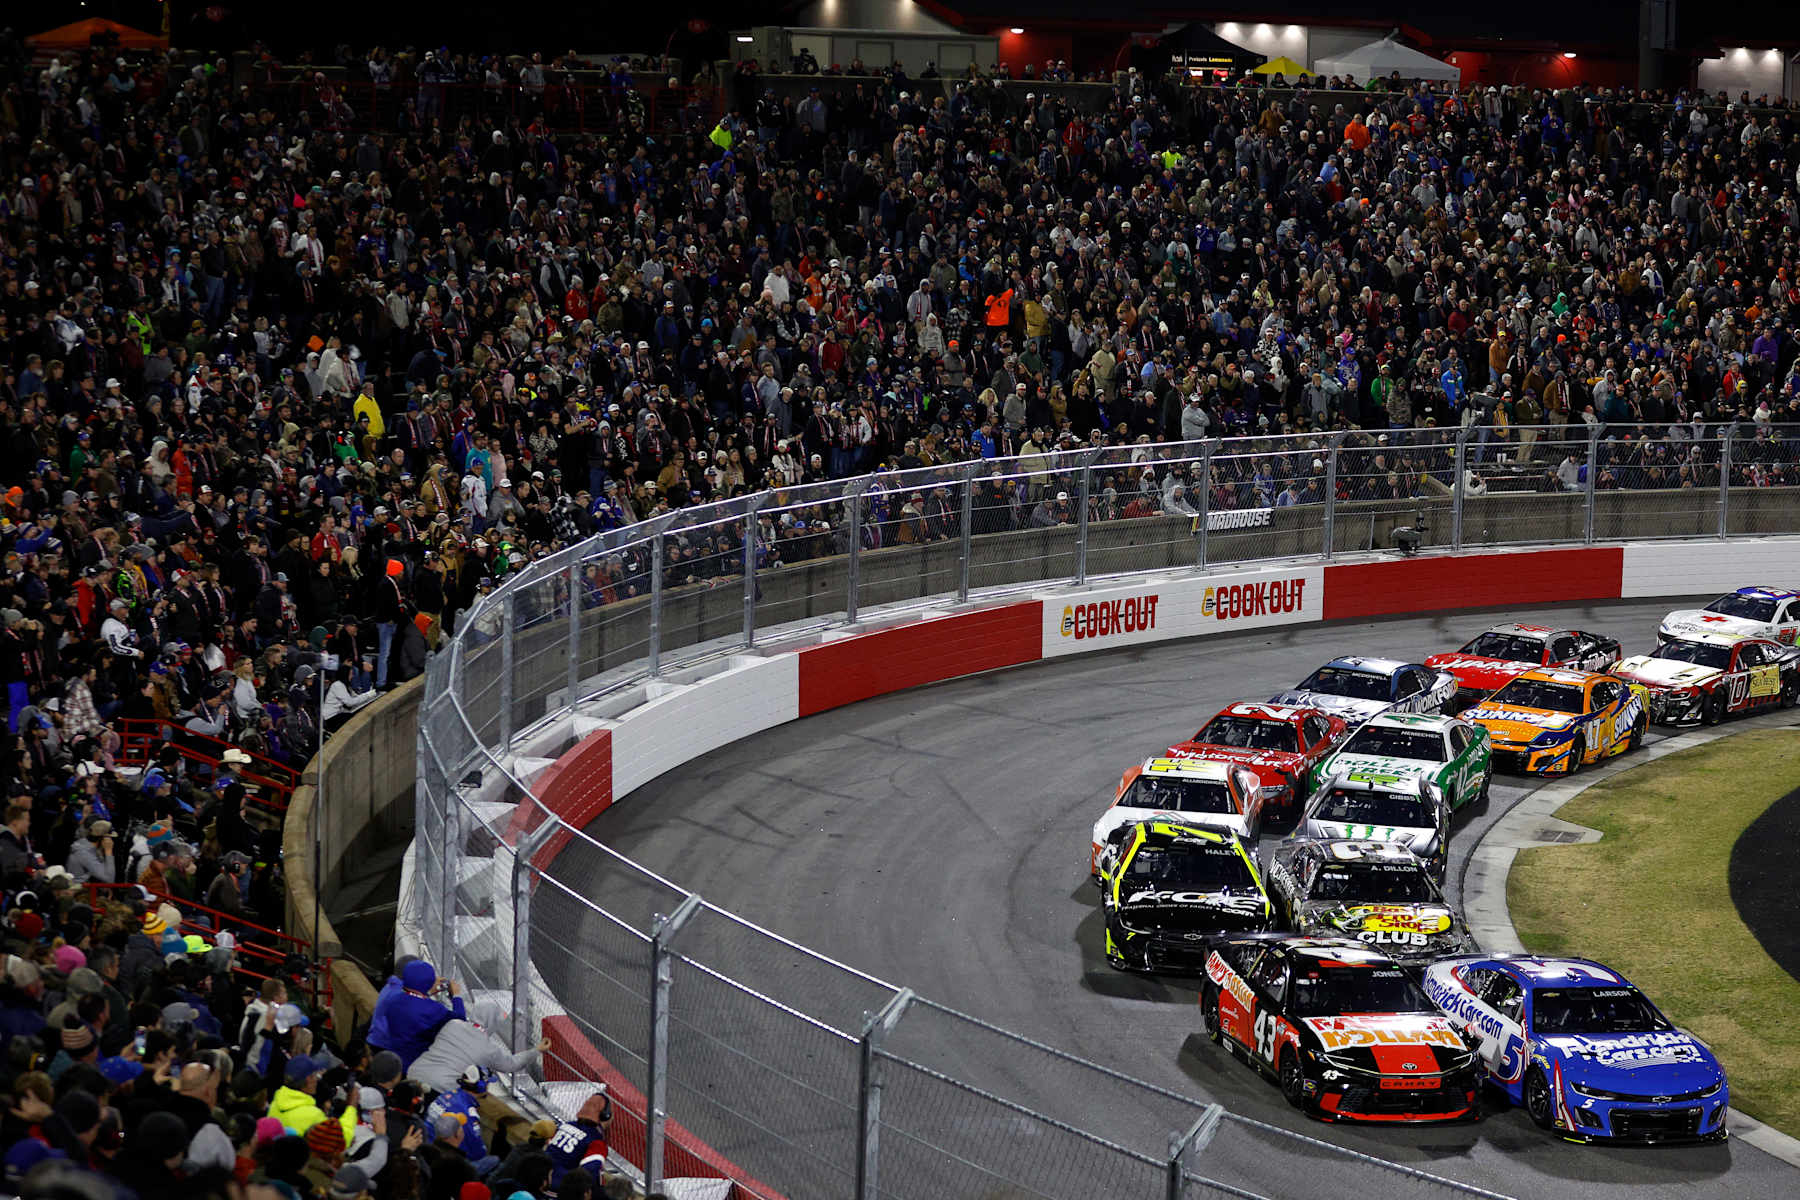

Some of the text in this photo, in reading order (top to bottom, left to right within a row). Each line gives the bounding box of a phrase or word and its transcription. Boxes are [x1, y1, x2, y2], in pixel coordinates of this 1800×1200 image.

[1206, 510, 1272, 531] MADHOUSE
[1388, 794, 1416, 802] GIBBS
[1205, 849, 1238, 857] HALEY
[1383, 865, 1418, 874] DILLON
[1356, 931, 1429, 947] CLUB
[1371, 970, 1404, 978] JONES
[1592, 990, 1632, 998] LARSON
[1253, 1008, 1277, 1062] 43
[1498, 1032, 1527, 1082] 5
[1381, 1080, 1439, 1088] CAMRY
[1581, 1099, 1596, 1109] 5
